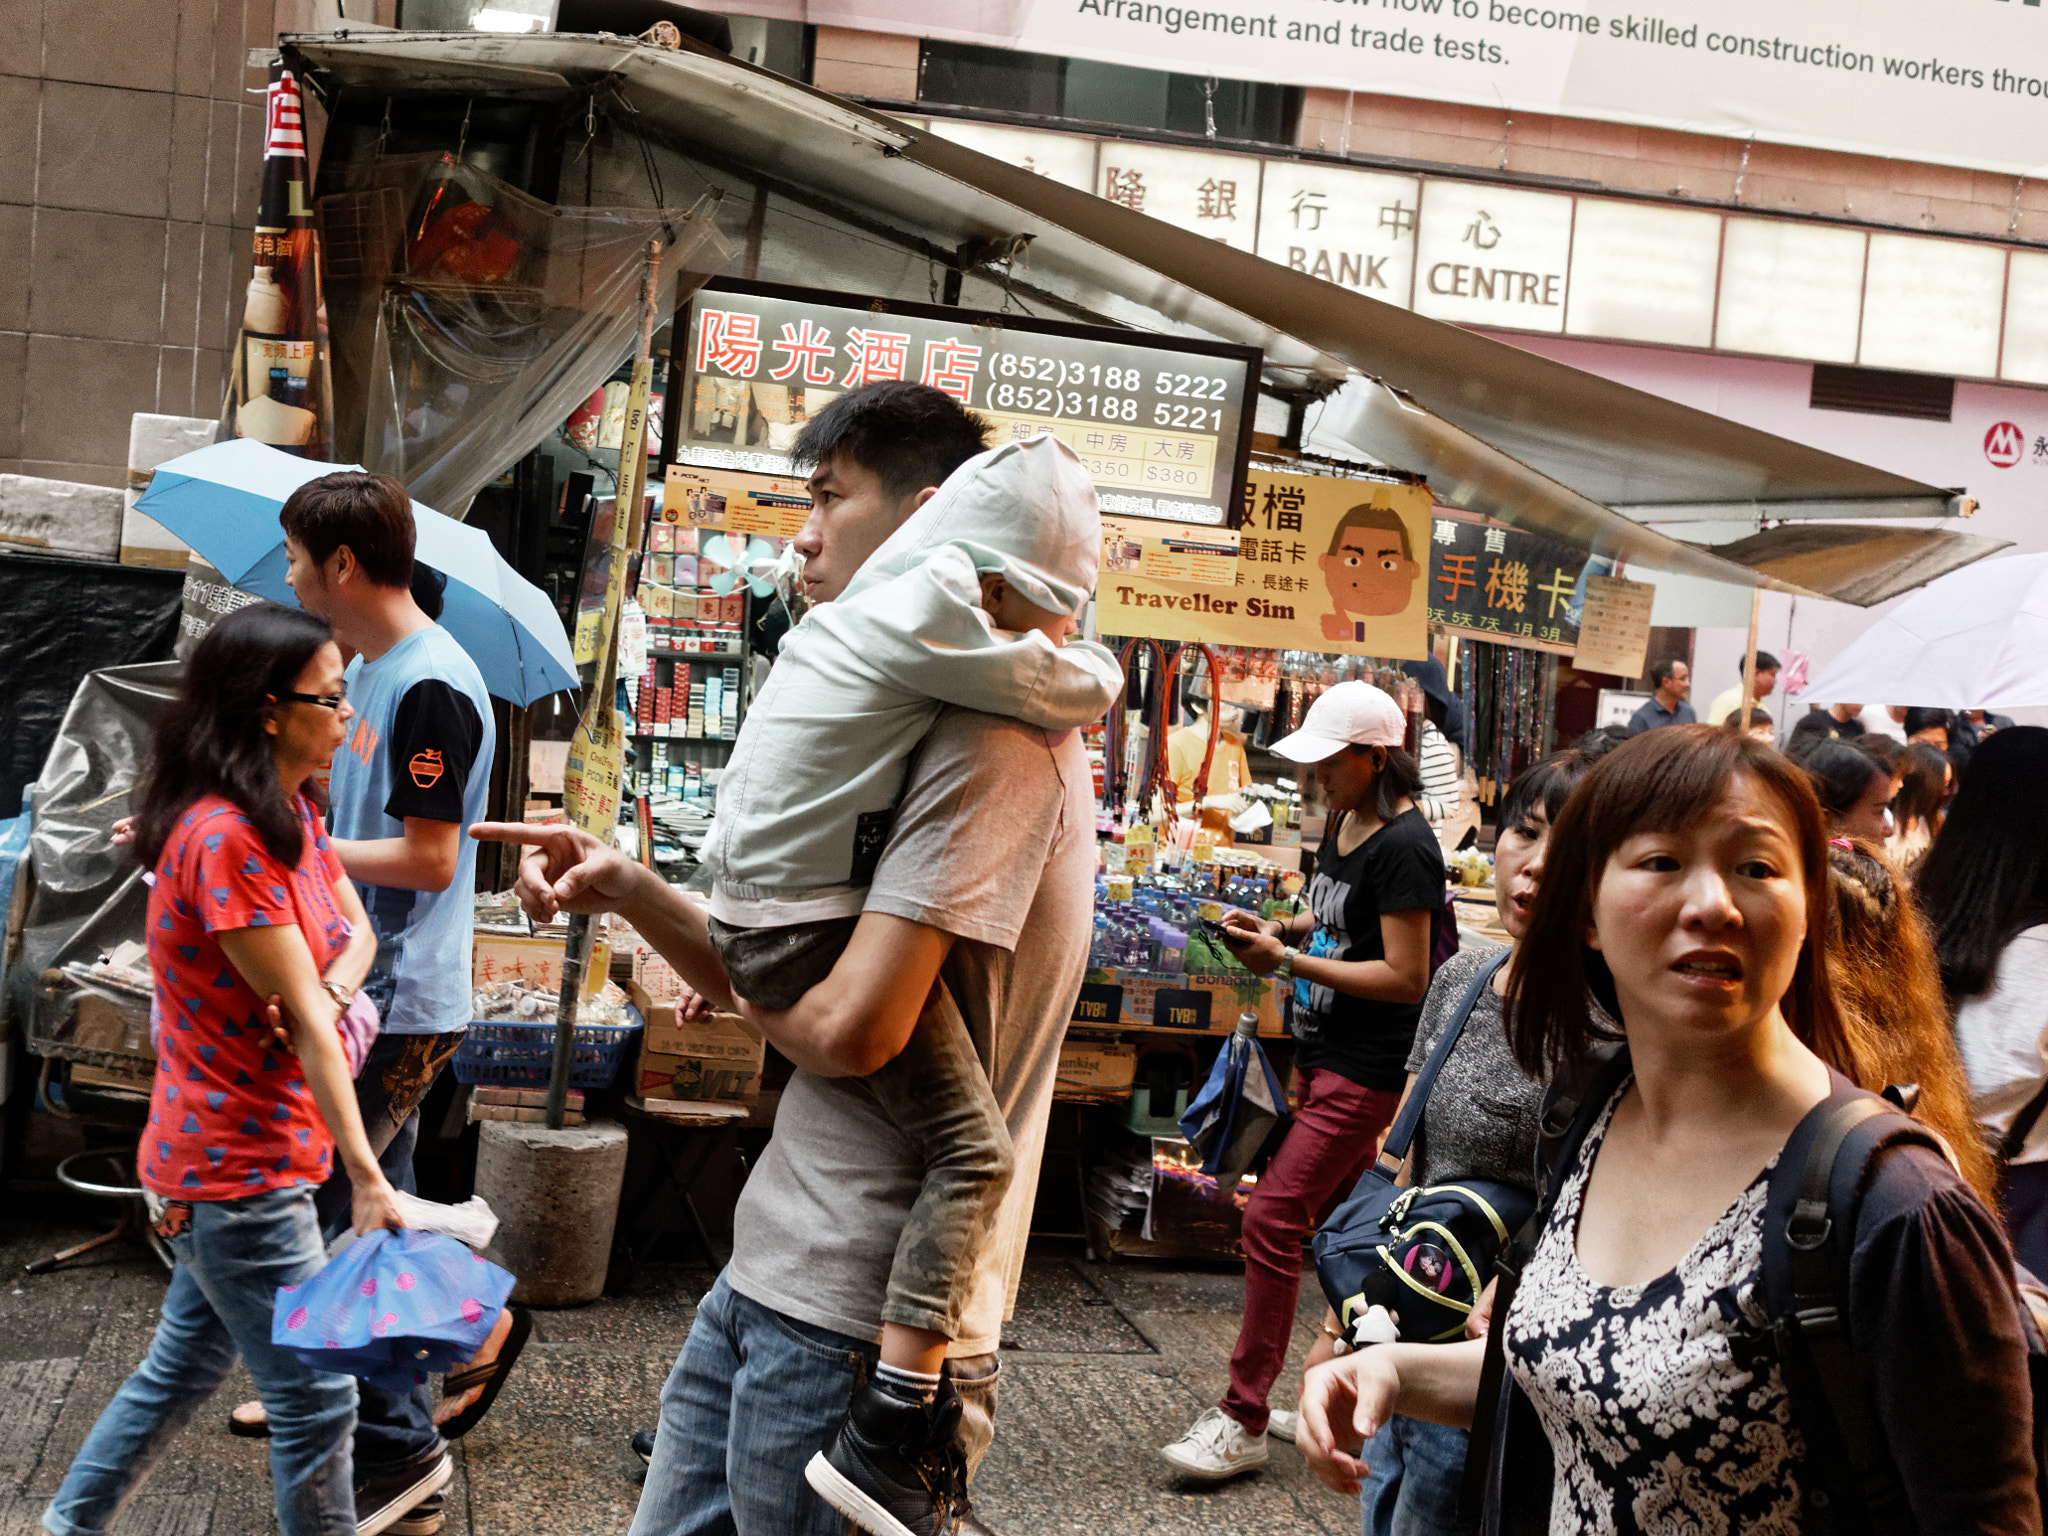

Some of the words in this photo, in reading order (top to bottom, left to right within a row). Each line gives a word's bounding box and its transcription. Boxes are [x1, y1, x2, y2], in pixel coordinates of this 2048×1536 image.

[1078, 0, 1278, 39] Arrangement
[1286, 20, 1341, 45] and
[1350, 24, 1425, 55] trade
[1434, 33, 1510, 66] tests.
[1453, 0, 1479, 18] to
[1489, 0, 1600, 34] become
[1608, 15, 1698, 49] skilled
[1706, 32, 1875, 73] construction
[1884, 57, 1985, 89] workers
[1289, 246, 1389, 289] BANK
[1427, 262, 1560, 306] CENTRE
[695, 308, 983, 404] 陽光酒店
[988, 352, 1141, 391] (852)3188
[1155, 371, 1228, 401] 5222
[986, 382, 1138, 422] (852)3188
[1153, 402, 1223, 431] 5221
[1086, 431, 1128, 453] 中房
[1153, 438, 1196, 461] 大房
[1080, 458, 1130, 477] $350
[1147, 465, 1198, 486] $380
[1239, 536, 1307, 565] 電話卡
[1116, 585, 1239, 615] Traveller
[1245, 597, 1296, 620] Sim
[1436, 554, 1578, 619] 手機卡
